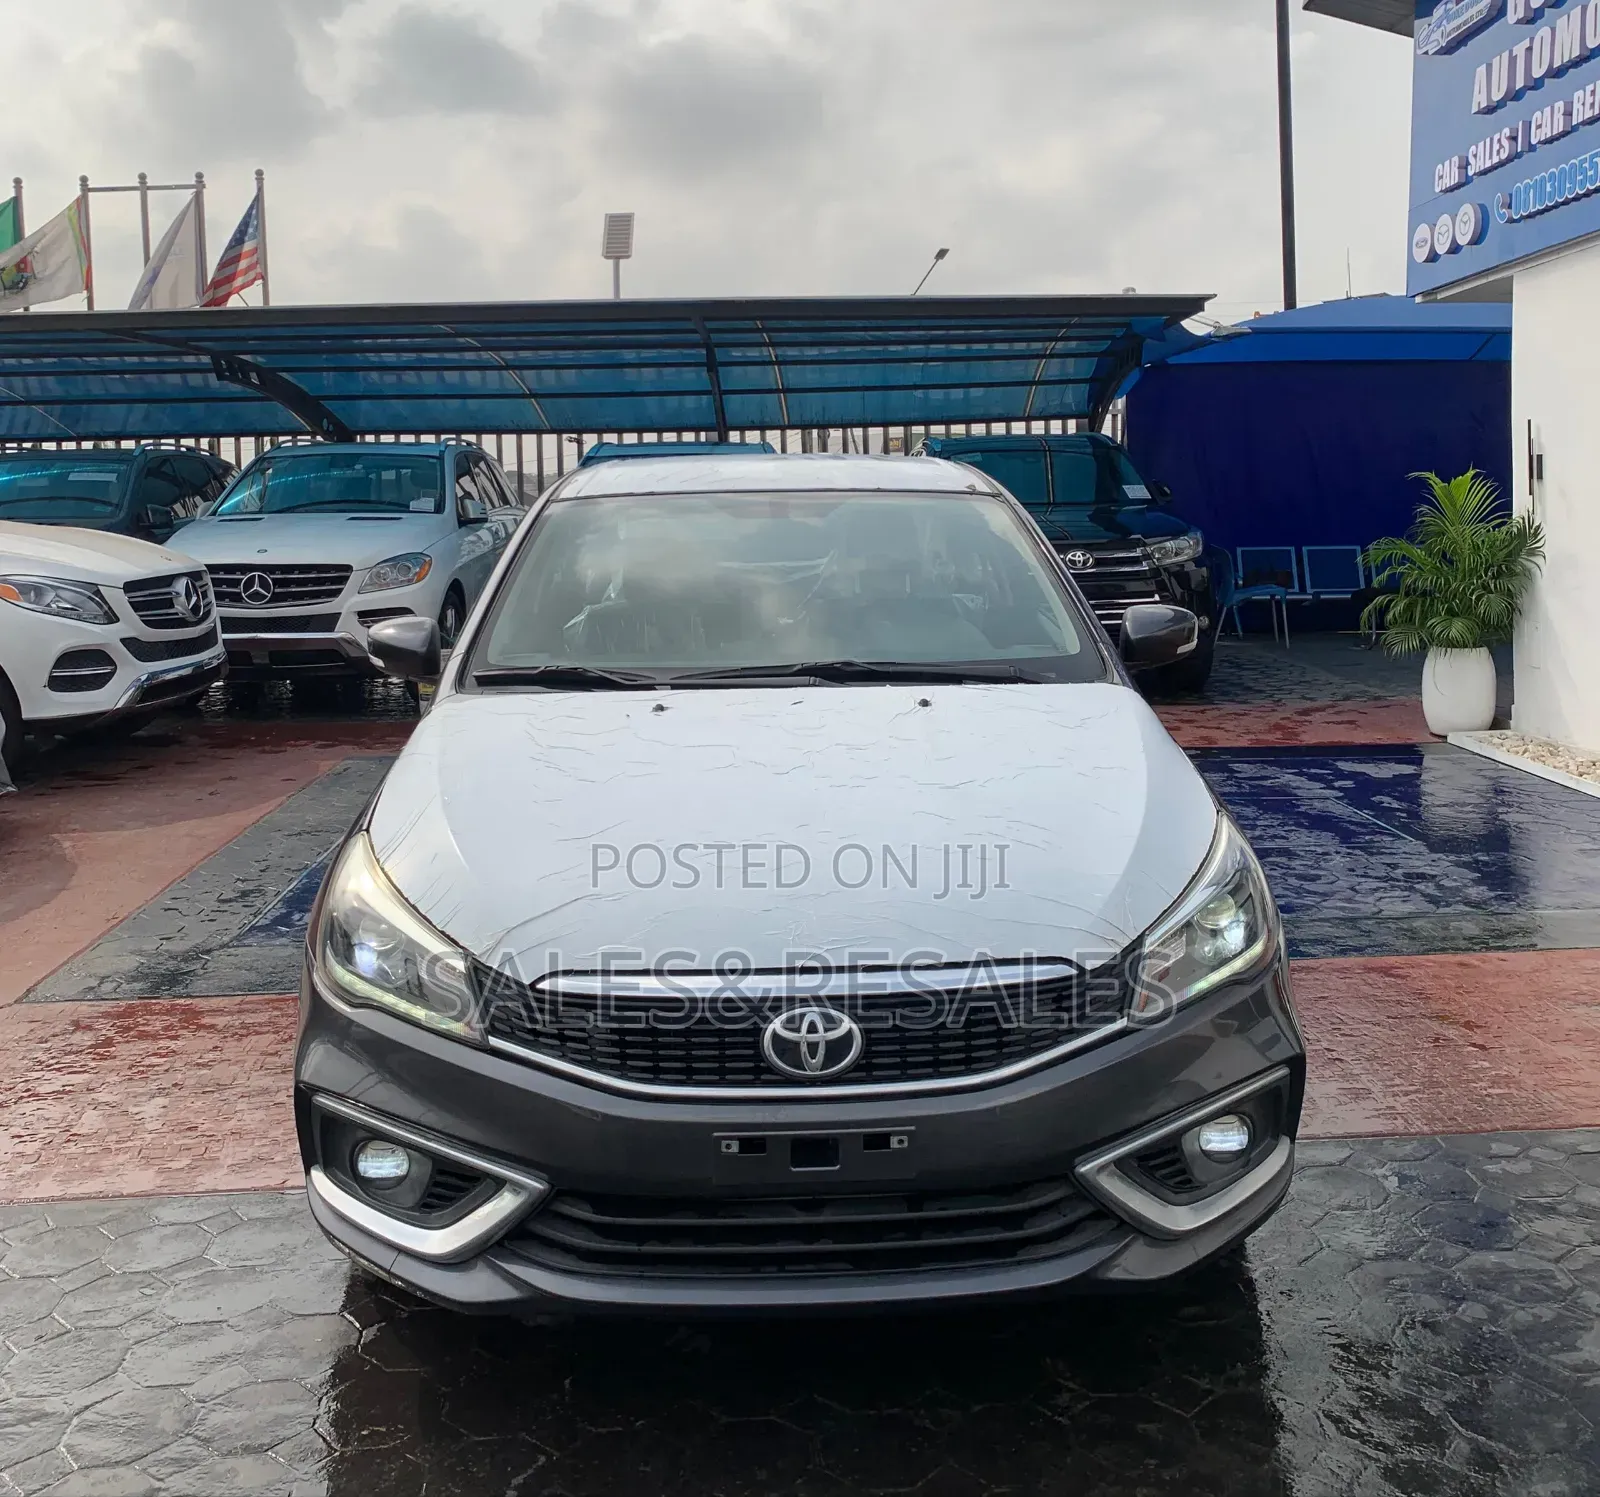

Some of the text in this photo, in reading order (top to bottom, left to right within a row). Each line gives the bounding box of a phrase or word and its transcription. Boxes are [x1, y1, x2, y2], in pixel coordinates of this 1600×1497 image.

[1435, 155, 1460, 193] CAR
[1467, 127, 1511, 176] SALES
[1530, 100, 1565, 145] CAR
